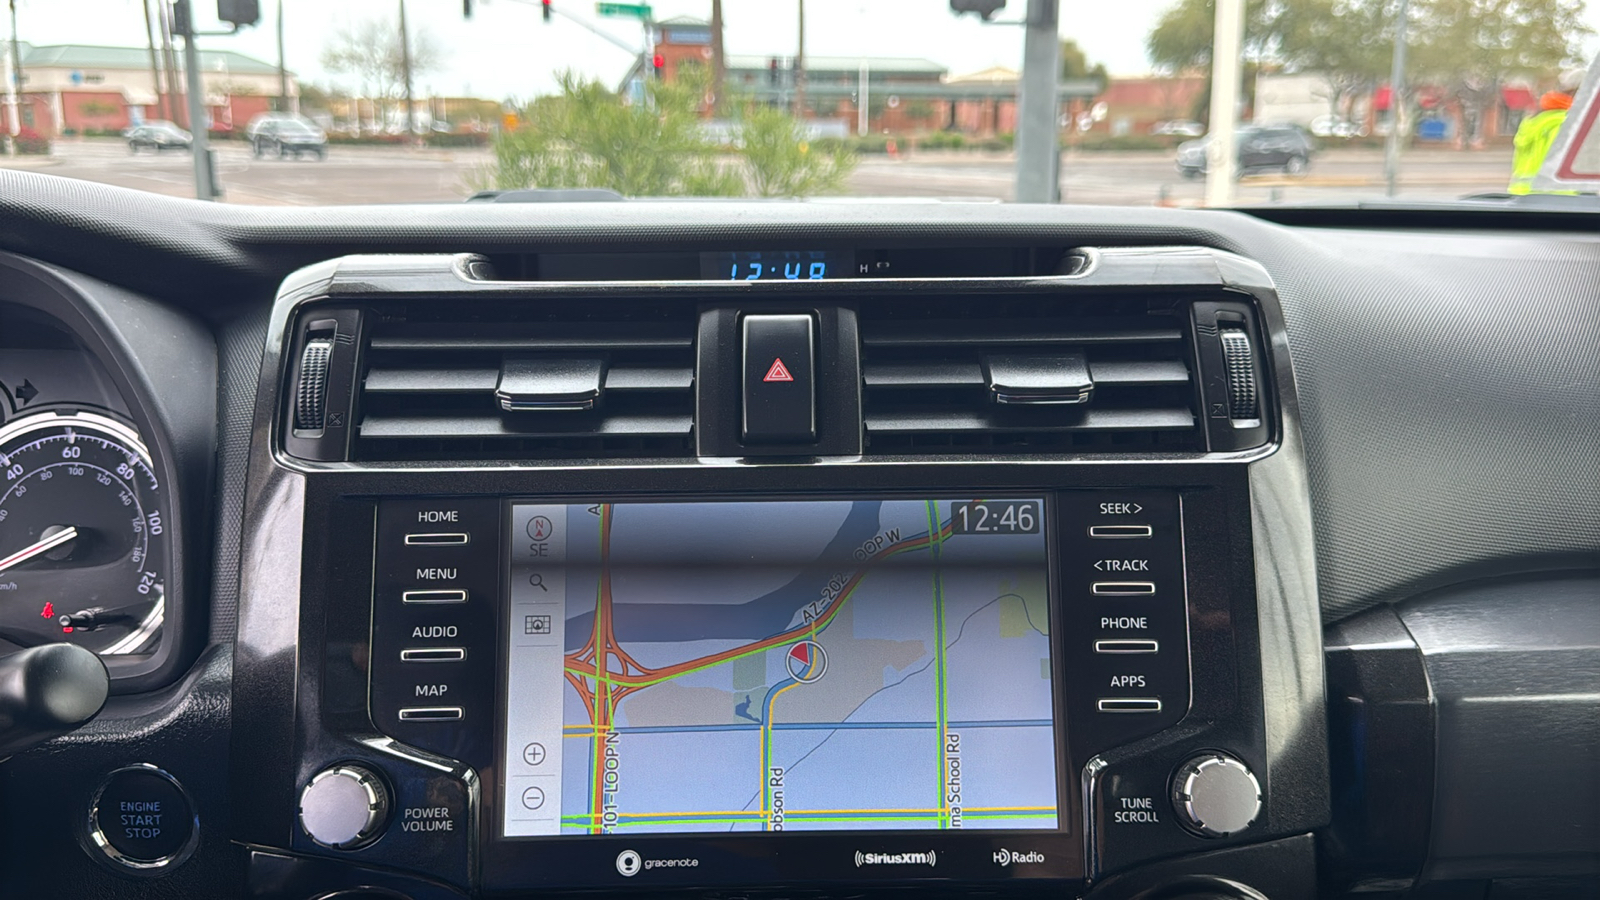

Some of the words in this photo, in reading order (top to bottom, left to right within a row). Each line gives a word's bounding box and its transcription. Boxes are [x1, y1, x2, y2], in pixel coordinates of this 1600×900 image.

[61, 446, 81, 459] 60
[7, 463, 24, 481] 40
[40, 470, 53, 481] 80
[68, 467, 84, 476] 100
[116, 462, 135, 481] 80
[96, 473, 112, 486] 120
[15, 485, 27, 497] 60
[118, 490, 132, 506] 140
[147, 509, 163, 536] 100
[418, 510, 459, 523] HOME
[957, 504, 1035, 532] 12:46
[131, 516, 142, 533] 160
[535, 519, 544, 530] N
[885, 527, 902, 542] W
[132, 546, 142, 563] 180
[529, 543, 548, 557] SE
[416, 568, 457, 580] MENU
[137, 570, 157, 595] 120
[1101, 617, 1148, 629] PHONE
[412, 626, 458, 638] AUDIO
[1110, 675, 1146, 687] APPS
[415, 684, 448, 696] MAP
[606, 731, 620, 743] N
[946, 734, 960, 753] Rd
[769, 767, 784, 787] Rd
[946, 757, 961, 803] School
[120, 801, 161, 812] ENGINE
[1120, 797, 1153, 809] TUNE
[404, 807, 449, 819] POWER
[769, 791, 784, 832] obson
[951, 806, 961, 827] ma
[1114, 811, 1160, 823] SCROLL
[120, 814, 162, 826] START
[401, 820, 453, 832] VOLUME
[125, 828, 161, 839] STOP
[1012, 851, 1045, 863] Radio
[644, 858, 699, 870] gracenote
